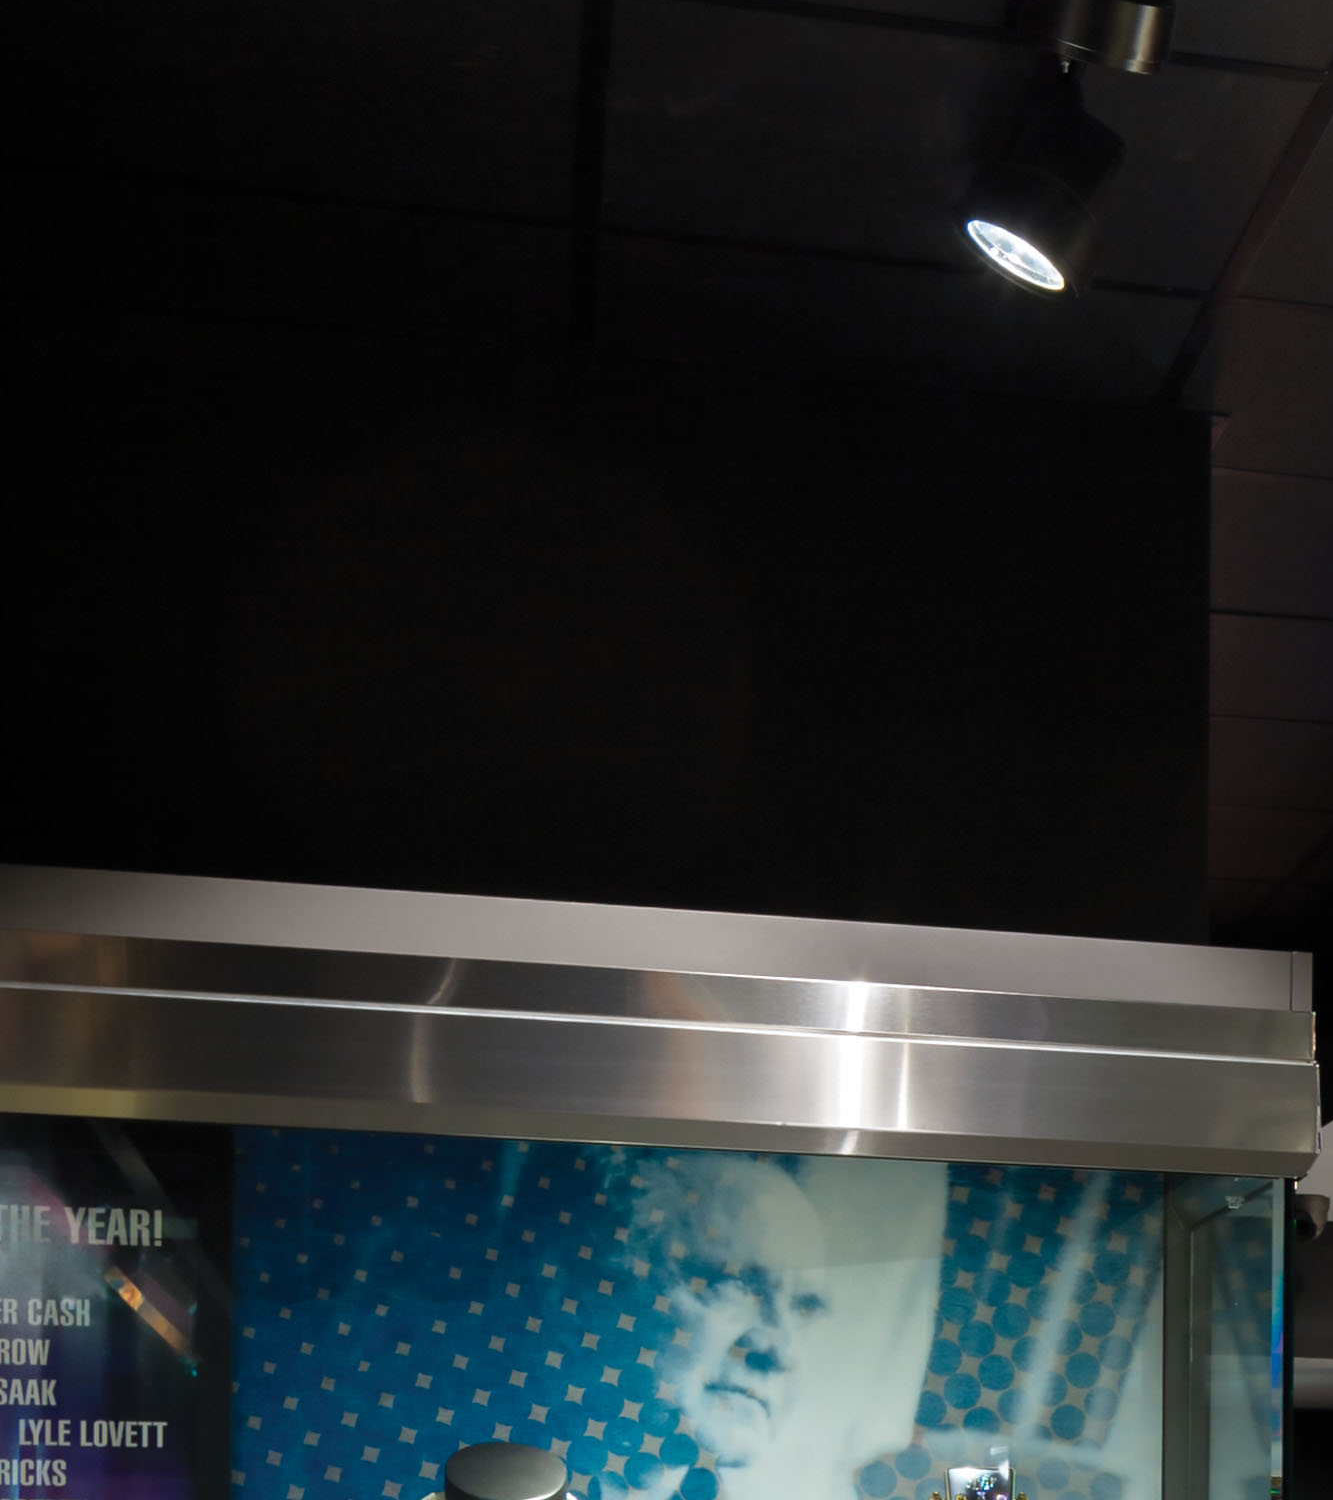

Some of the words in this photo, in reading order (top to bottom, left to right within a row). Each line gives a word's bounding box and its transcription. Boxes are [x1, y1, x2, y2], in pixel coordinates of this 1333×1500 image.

[64, 1206, 163, 1247] YEAR!
[28, 1298, 91, 1327] CASH
[0, 1337, 50, 1366] ROW
[19, 1418, 71, 1446] LYLE
[80, 1420, 168, 1448] LOVETT
[0, 1458, 67, 1487] RICKS
